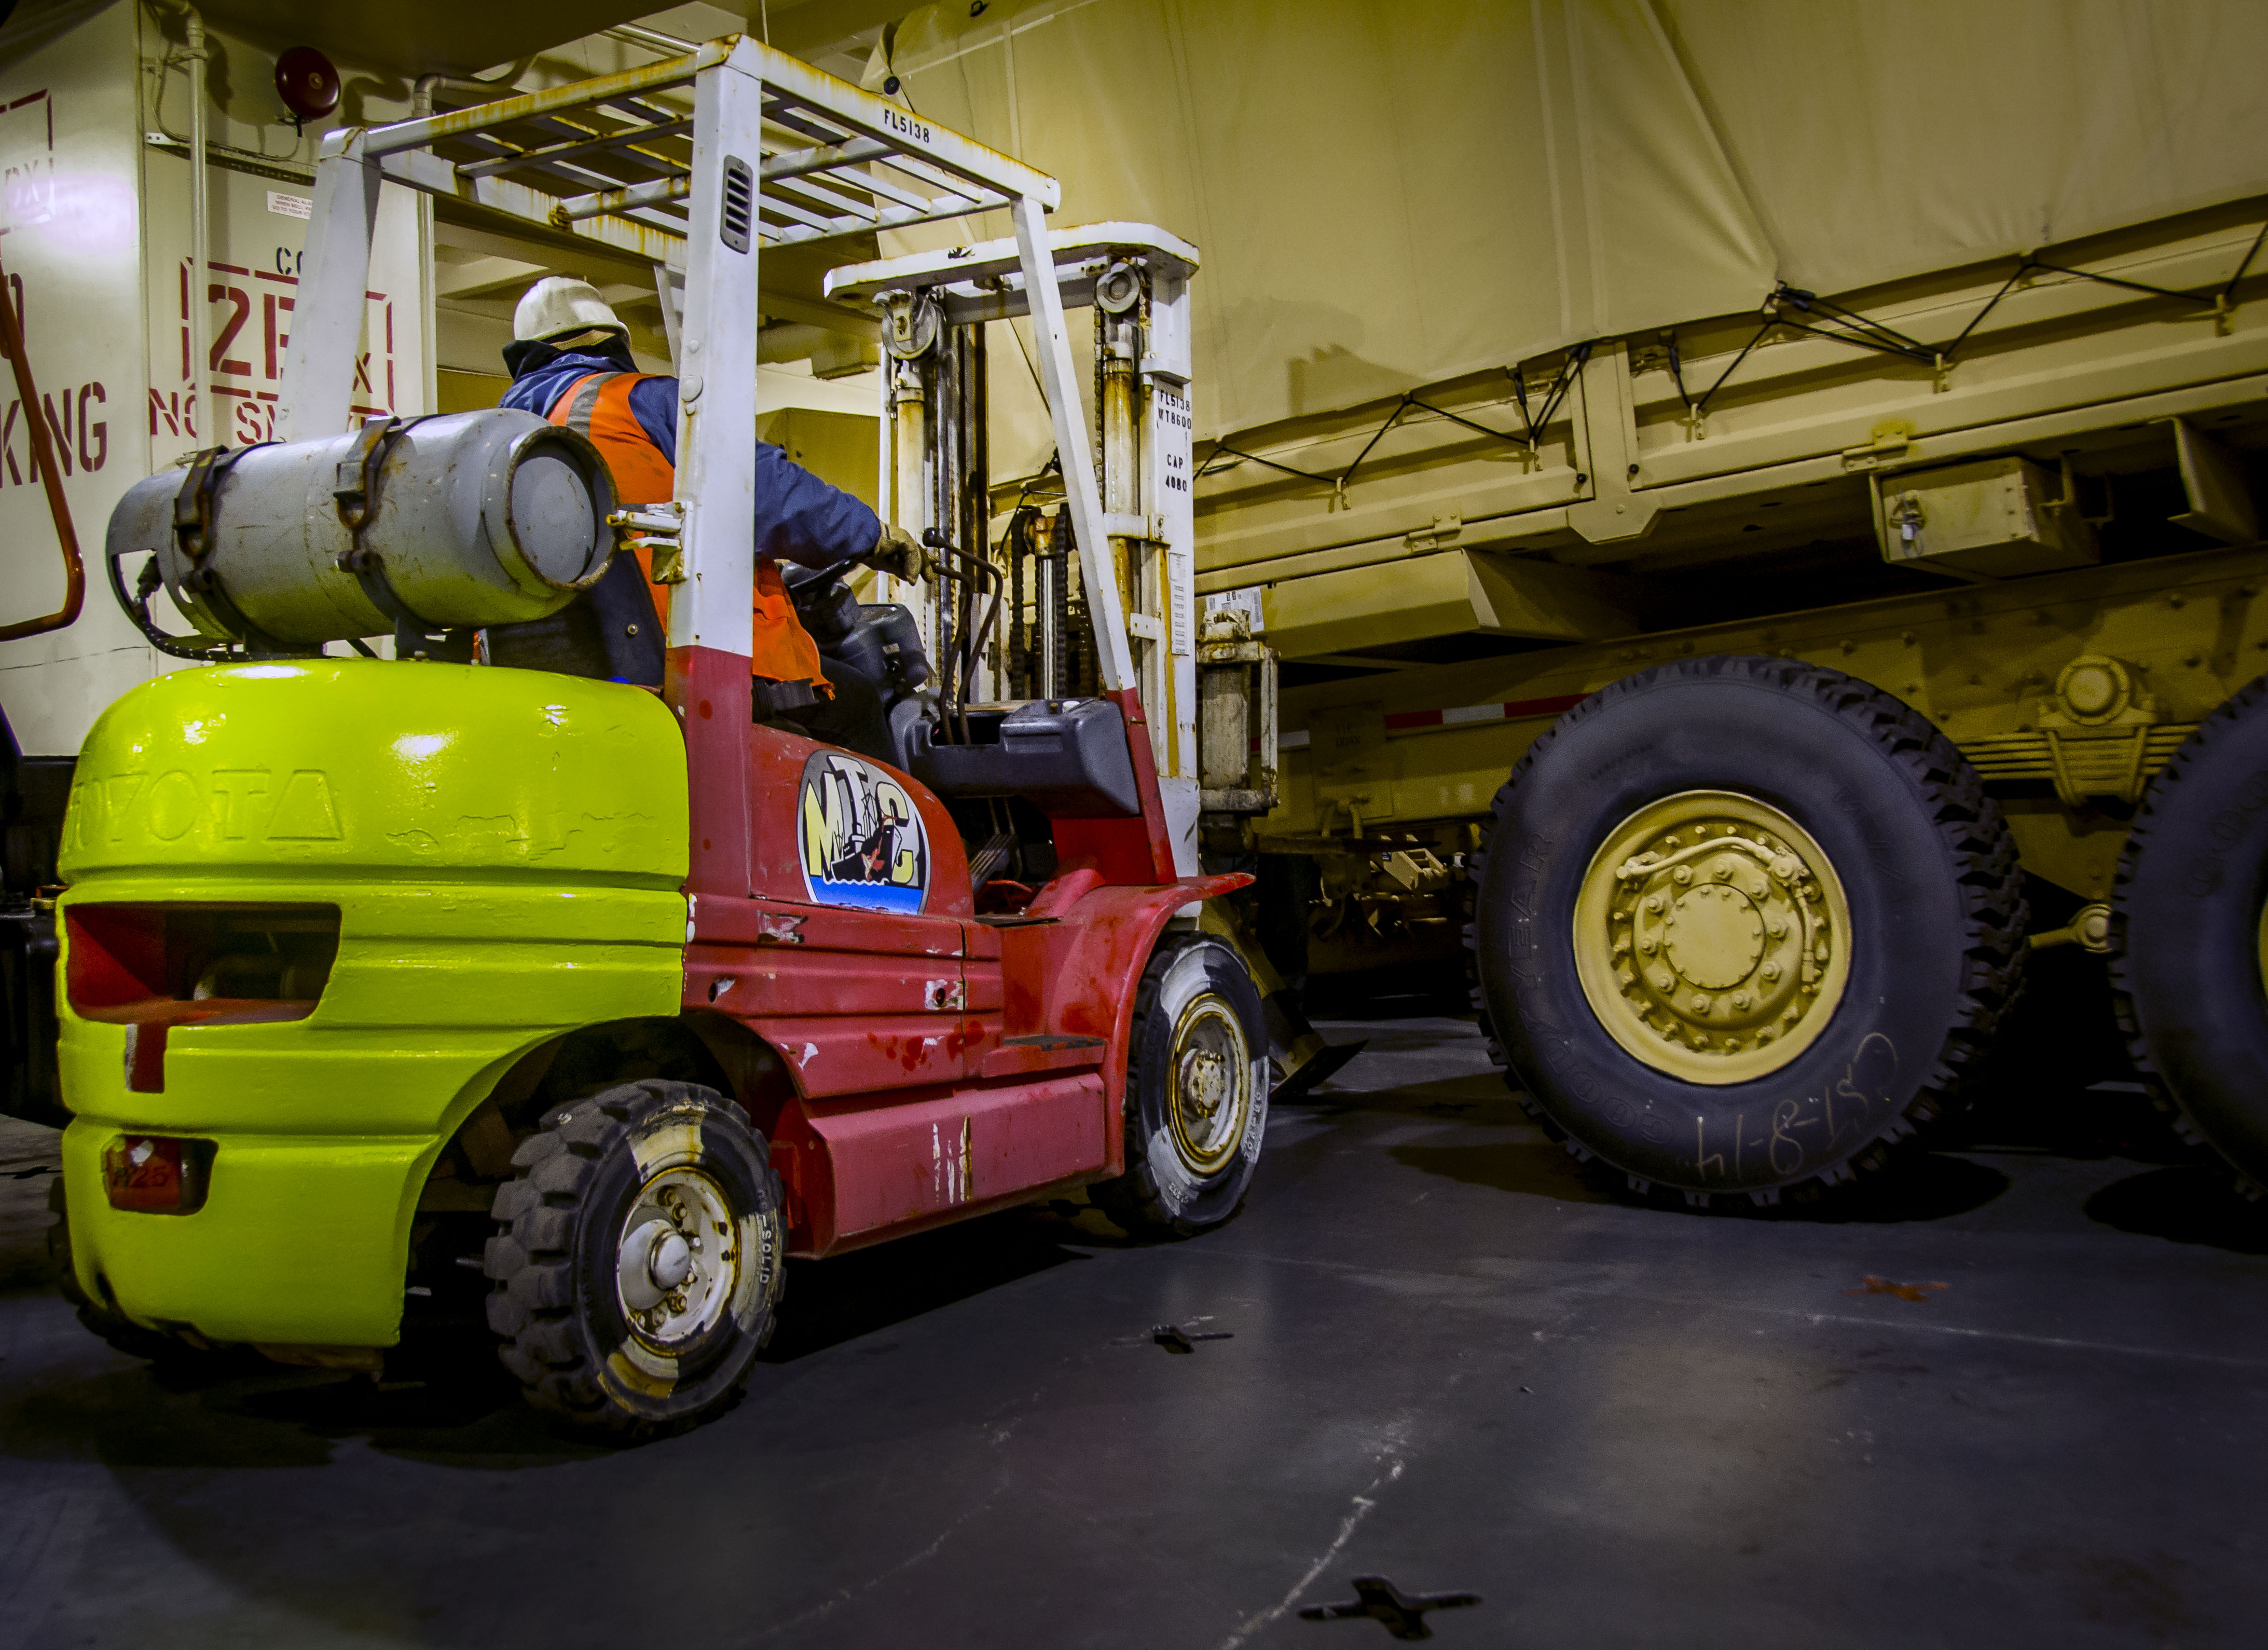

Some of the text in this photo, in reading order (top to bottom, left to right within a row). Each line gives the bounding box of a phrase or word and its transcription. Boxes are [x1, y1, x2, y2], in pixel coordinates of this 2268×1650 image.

[884, 108, 930, 143] FL5138
[1160, 389, 1190, 412] FL5138
[1167, 454, 1183, 470] CAP
[1165, 474, 1187, 492] 4080
[1508, 832, 1675, 1144] GOODYEAR
